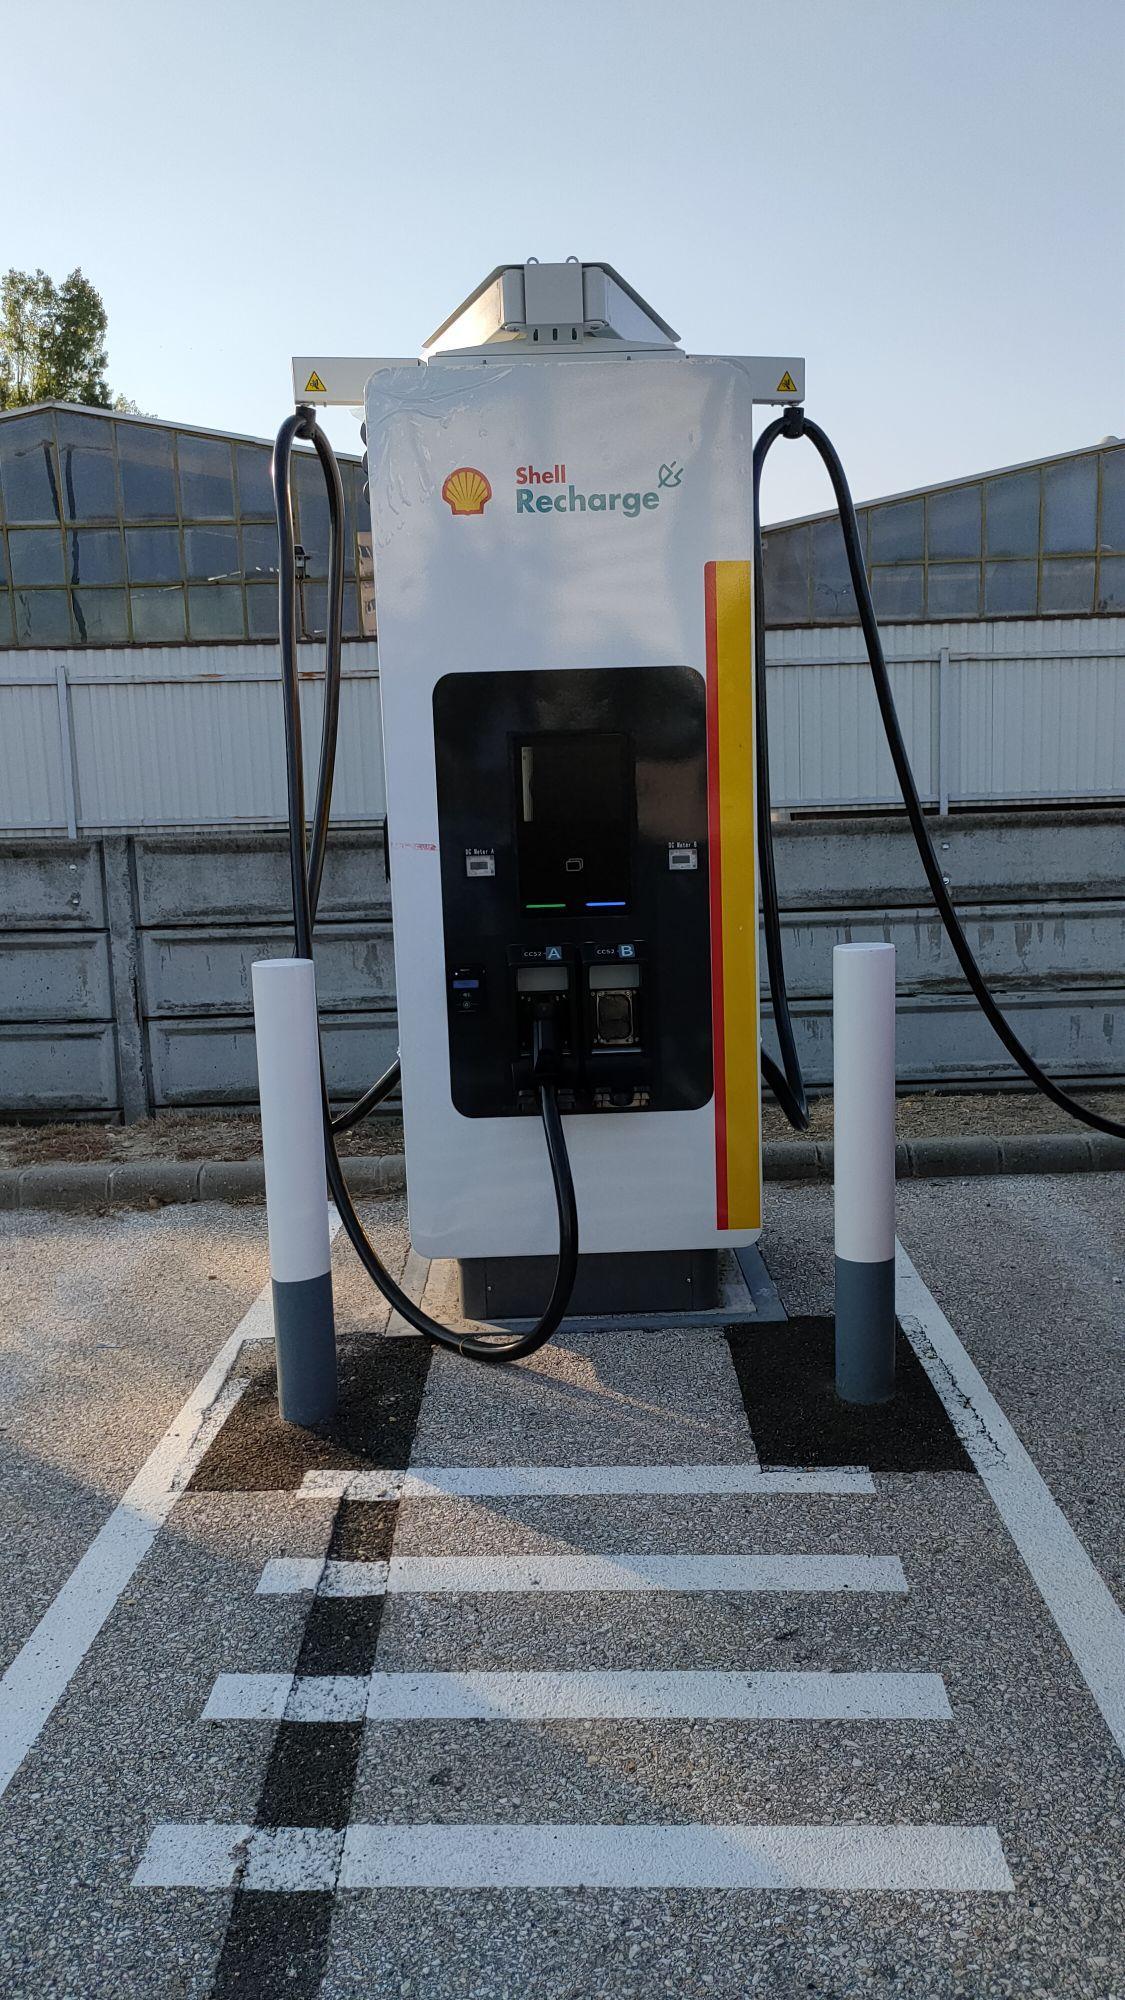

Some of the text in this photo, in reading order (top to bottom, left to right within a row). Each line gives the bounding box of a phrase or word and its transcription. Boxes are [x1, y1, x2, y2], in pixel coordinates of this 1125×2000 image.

[516, 464, 566, 485] Shell
[516, 485, 660, 518] Recharge
[548, 947, 561, 959] A
[621, 945, 634, 957] B
